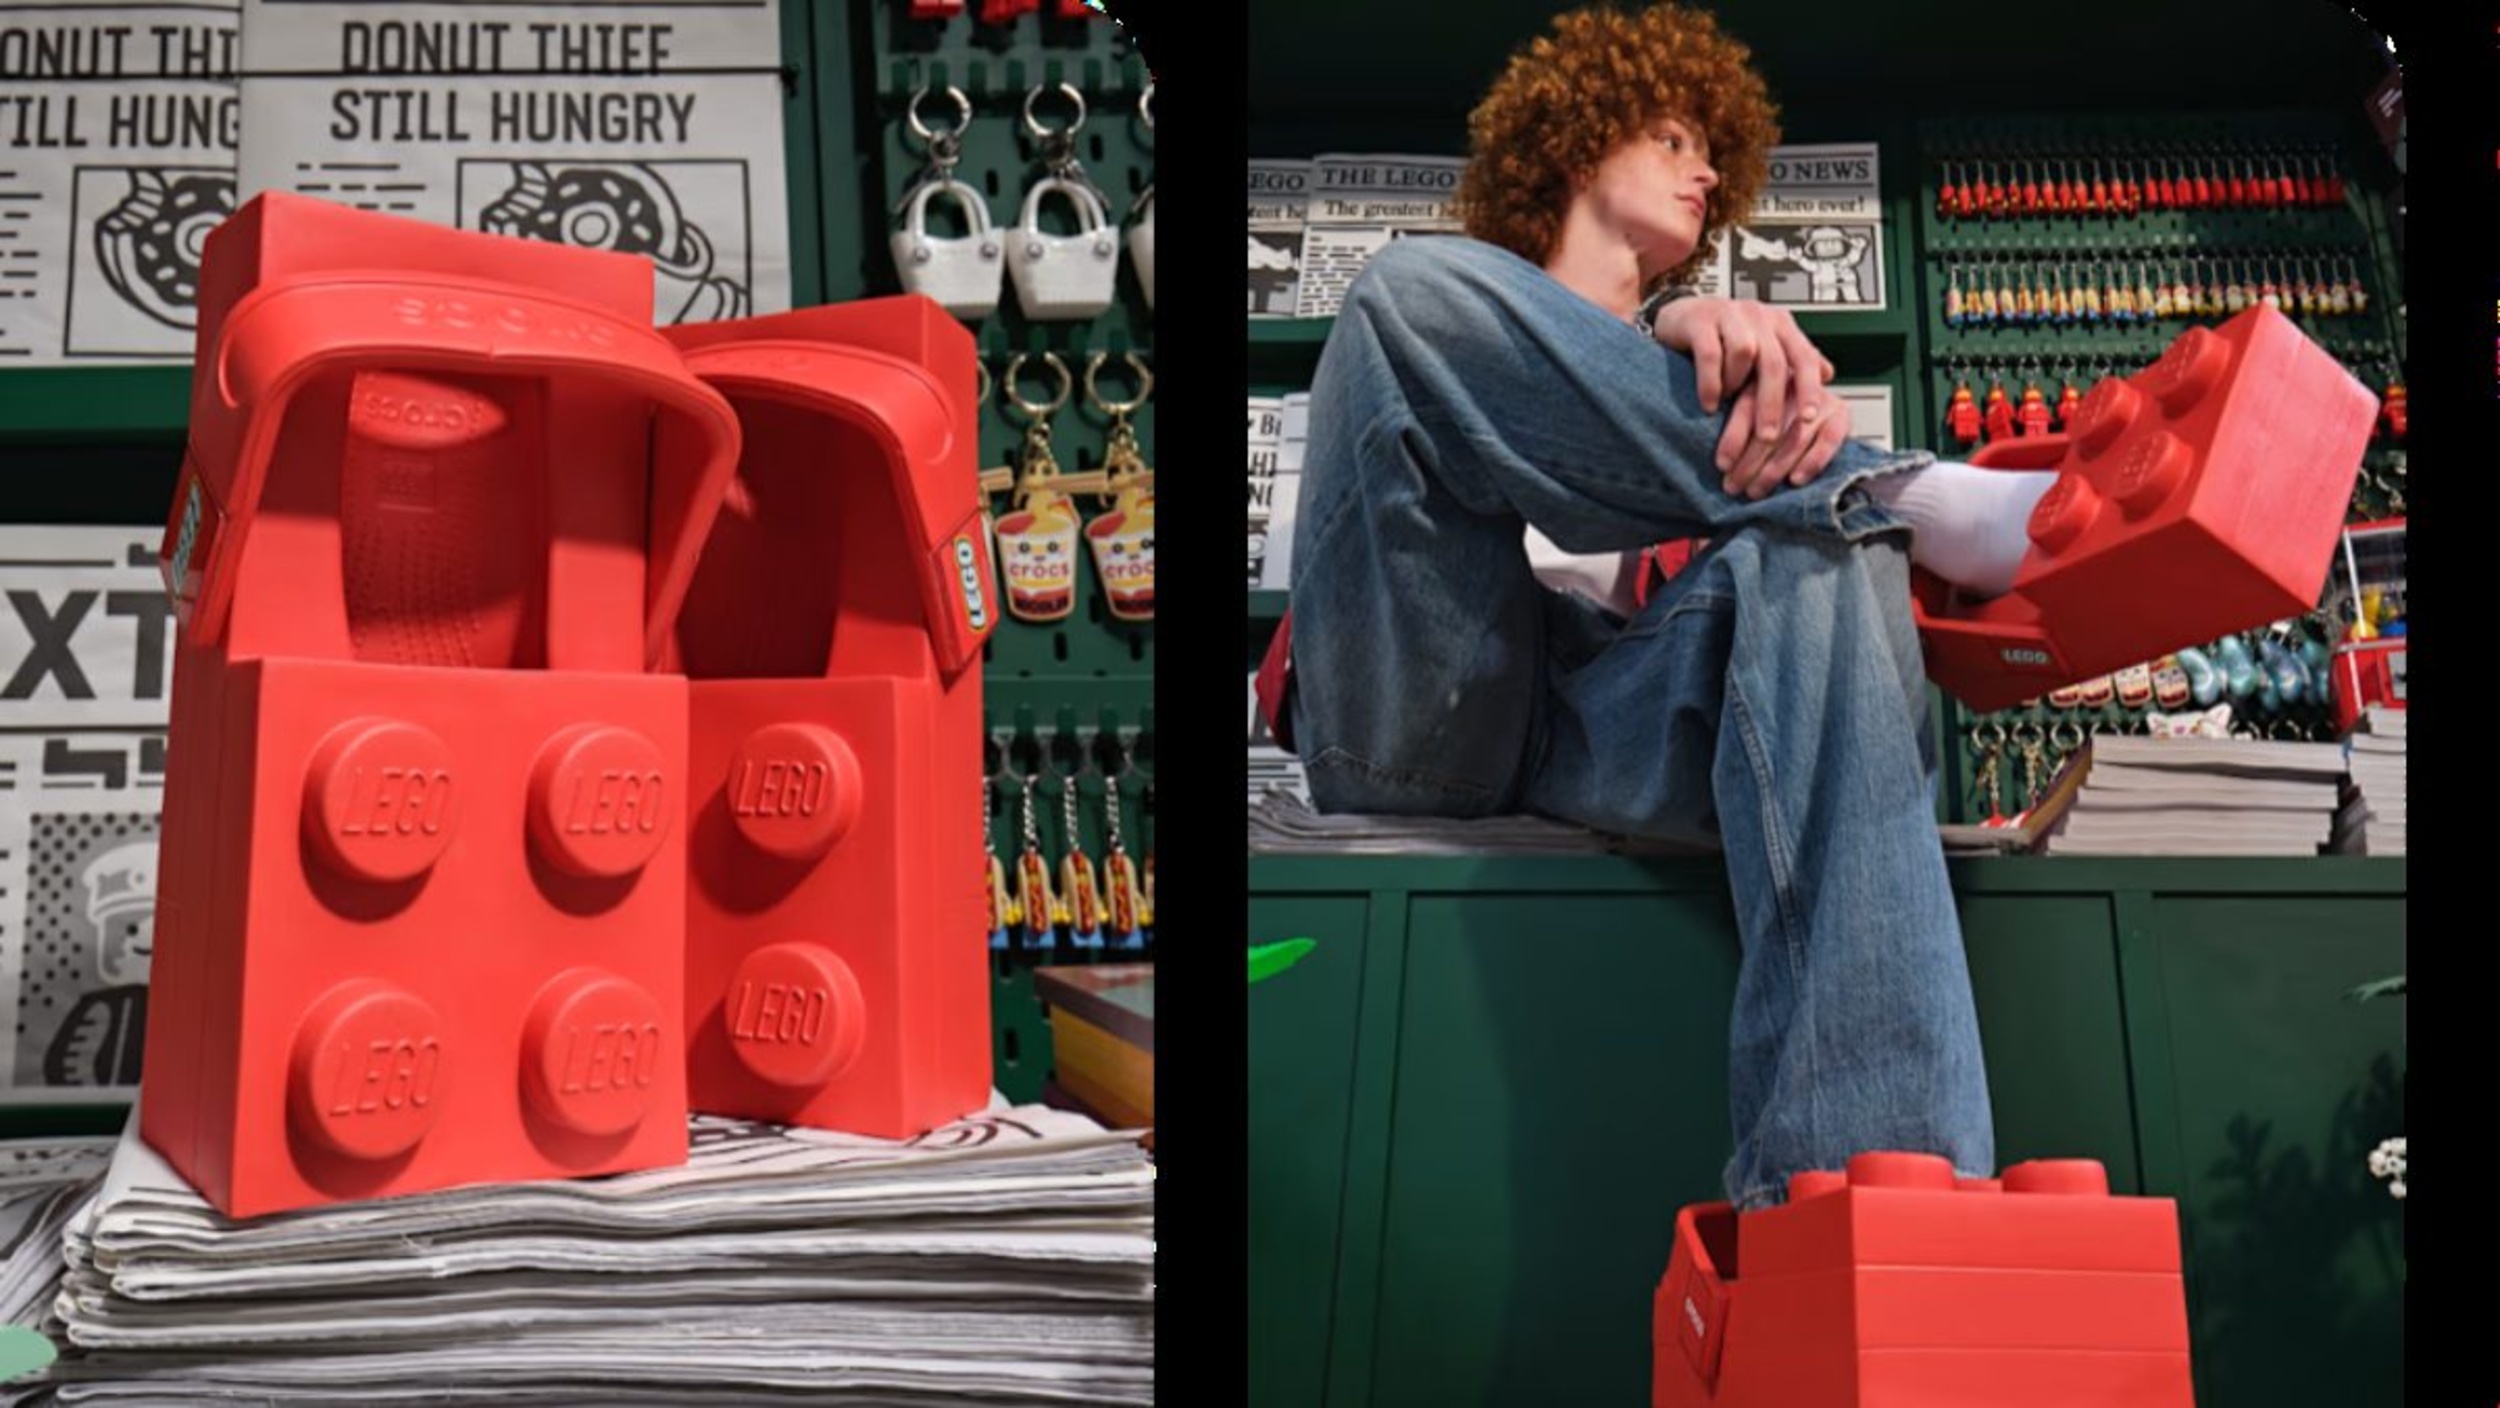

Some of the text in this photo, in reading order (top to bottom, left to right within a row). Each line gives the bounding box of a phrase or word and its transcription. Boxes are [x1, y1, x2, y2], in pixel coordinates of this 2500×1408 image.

[342, 21, 673, 76] DONUT THIEF
[330, 89, 695, 143] STILL HUNGRY
[1323, 166, 1455, 188] THE LEGO
[1794, 160, 1869, 181] NEWS
[1325, 199, 1357, 216] The
[1363, 201, 1434, 218] greatest
[1774, 195, 1813, 212] hero
[956, 537, 986, 631] LEGO
[1009, 562, 1069, 578] crocs
[0, 589, 174, 701] XT
[2003, 649, 2049, 665] LEGO
[341, 767, 450, 837] LEGO
[564, 768, 663, 836] LEGO
[735, 760, 827, 818] LEGO
[733, 980, 827, 1046] LEGO
[328, 1036, 440, 1118] LEGO
[559, 1021, 660, 1096] LEGO
